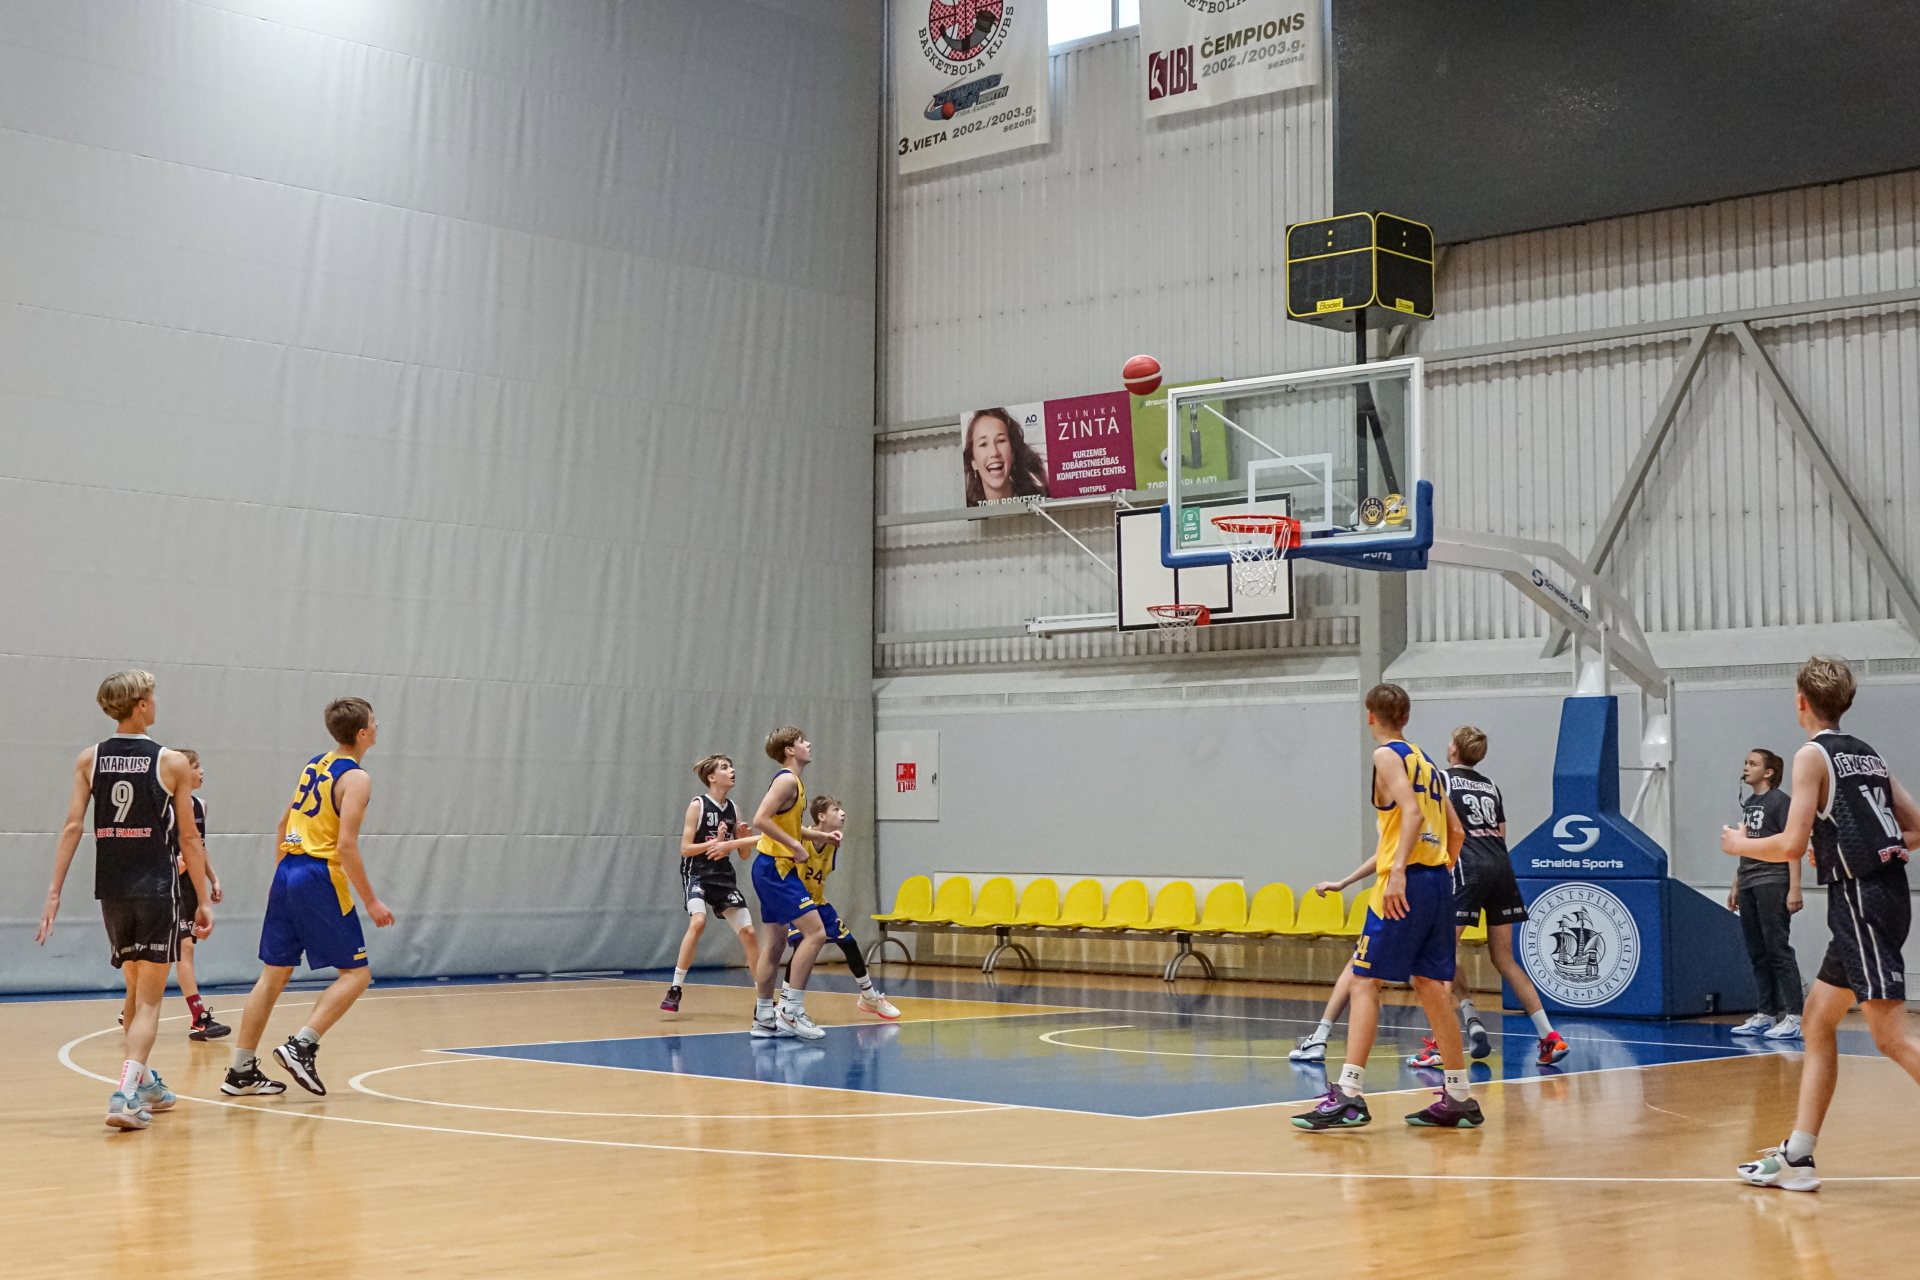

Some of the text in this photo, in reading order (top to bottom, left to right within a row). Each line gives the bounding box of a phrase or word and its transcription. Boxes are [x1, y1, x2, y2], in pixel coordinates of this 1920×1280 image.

[918, 6, 1015, 76] BASKETBOLA KLUBS
[1200, 13, 1305, 58] ČEMPIONS
[1202, 38, 1306, 77] 2002./2003.g.
[1169, 45, 1198, 96] LBL
[1058, 416, 1120, 441] ZINTA
[1062, 456, 1119, 471] ZOBĀRSTNIECĪBAS
[1072, 447, 1107, 459] KURZEMES
[1056, 465, 1127, 481] KOMPETENCES CENTRS
[1079, 485, 1107, 494] VENTSPILS
[99, 756, 151, 773] MARKUSS
[291, 767, 331, 818] 35
[1413, 764, 1442, 813] 44
[111, 780, 134, 823] 9
[1462, 793, 1498, 828] 30
[706, 812, 719, 827] 31
[115, 827, 152, 838] FAMILY
[804, 866, 823, 885] 24
[1531, 858, 1624, 870] Schelde Sports
[1537, 890, 1619, 920] VENTSPILS
